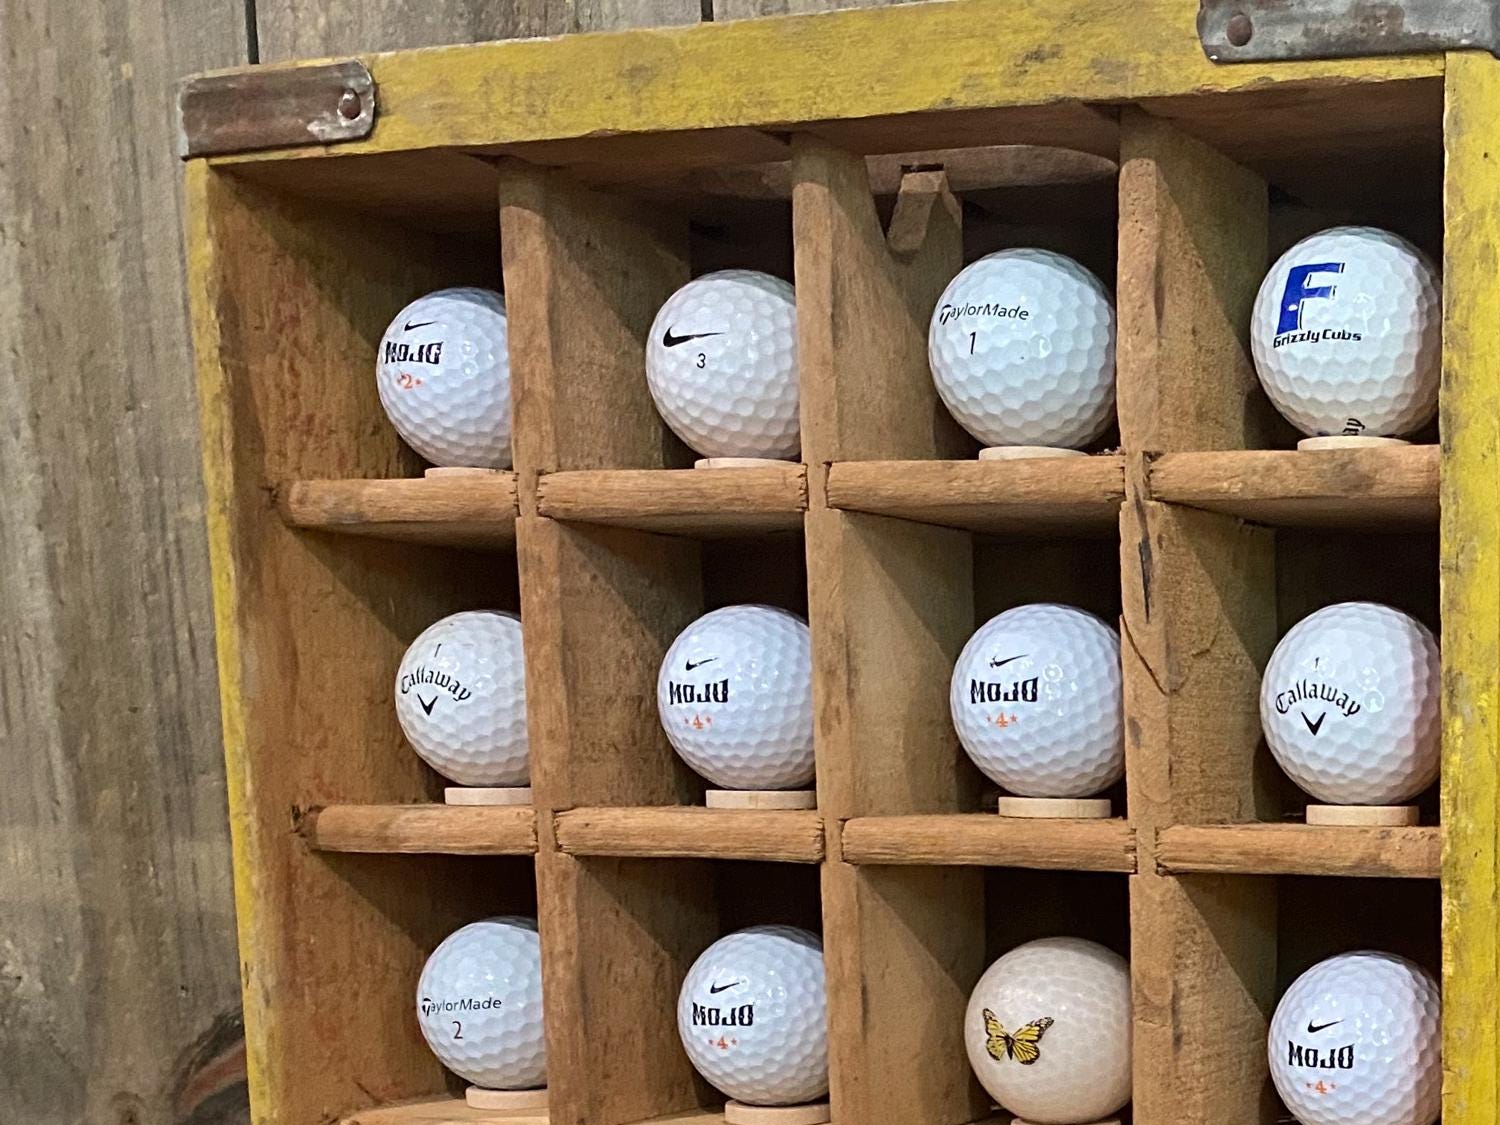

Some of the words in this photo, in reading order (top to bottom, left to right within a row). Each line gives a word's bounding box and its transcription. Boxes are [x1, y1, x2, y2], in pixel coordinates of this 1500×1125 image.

[1276, 262, 1346, 335] F
[940, 303, 1029, 325] TaylorMade
[969, 331, 977, 355] 1
[1273, 329, 1321, 348] Grizzly
[1322, 329, 1362, 341] Cubs
[697, 353, 706, 369] 3
[401, 664, 472, 702] Callaway
[970, 676, 1039, 704] MOJO
[1276, 678, 1361, 717] Callaway
[422, 997, 502, 1017] TaylorMade
[692, 1001, 757, 1027] MOJO
[452, 1020, 463, 1039] 2
[1288, 1040, 1355, 1069] MOJO
